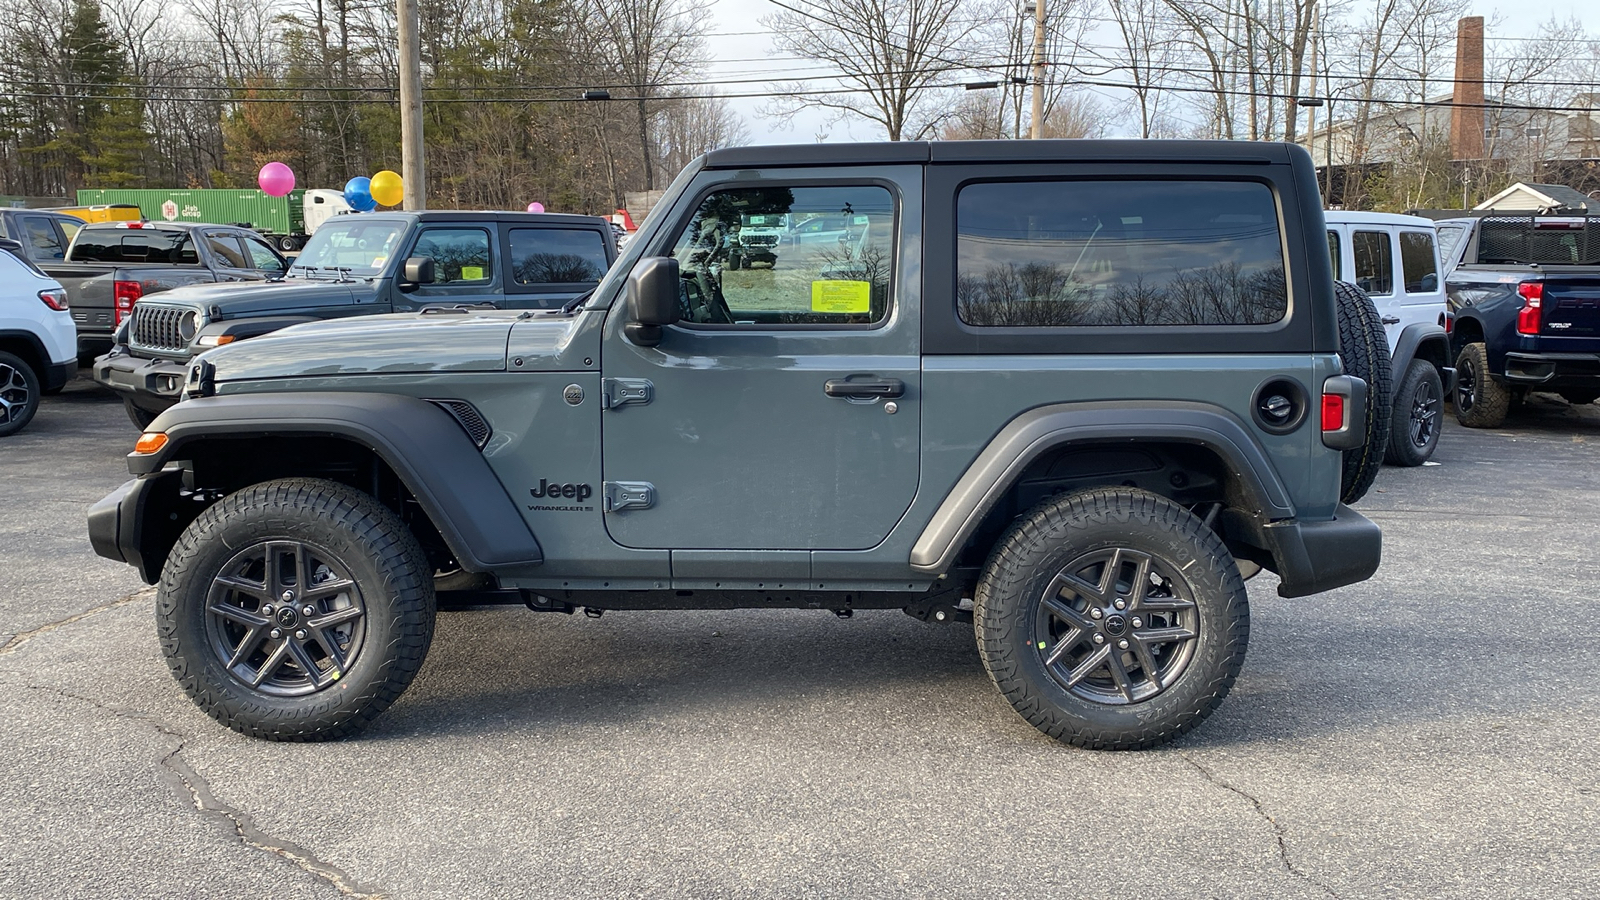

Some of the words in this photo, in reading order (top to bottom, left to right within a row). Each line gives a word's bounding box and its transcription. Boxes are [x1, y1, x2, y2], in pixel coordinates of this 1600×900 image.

[181, 209, 201, 218] Group
[530, 477, 592, 503] Jeep
[1014, 538, 1076, 629] NEXEN
